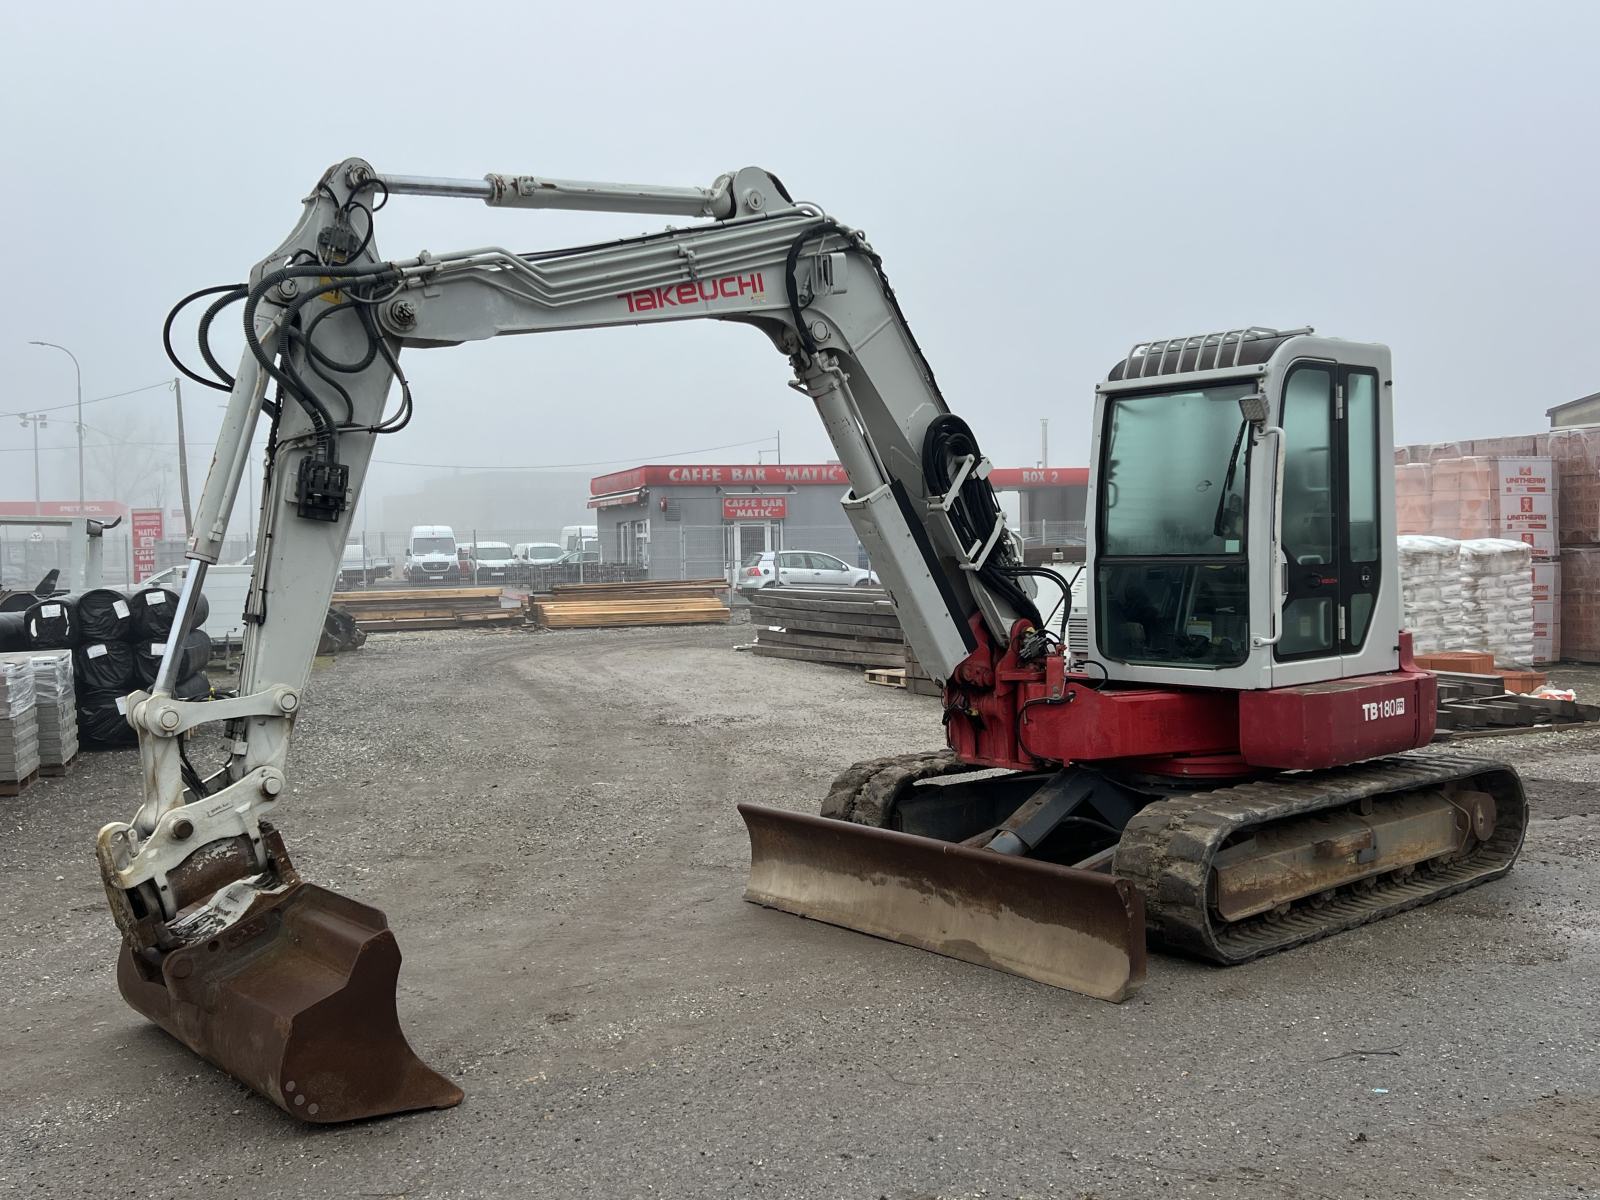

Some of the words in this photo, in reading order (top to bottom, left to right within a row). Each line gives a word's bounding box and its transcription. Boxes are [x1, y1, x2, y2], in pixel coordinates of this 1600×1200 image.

[668, 467, 722, 481] CAFFE
[732, 467, 766, 481] BAR
[1022, 471, 1045, 482] BOX
[1051, 471, 1059, 482] 2
[725, 499, 756, 508] CAFFE
[761, 499, 783, 508] BAR
